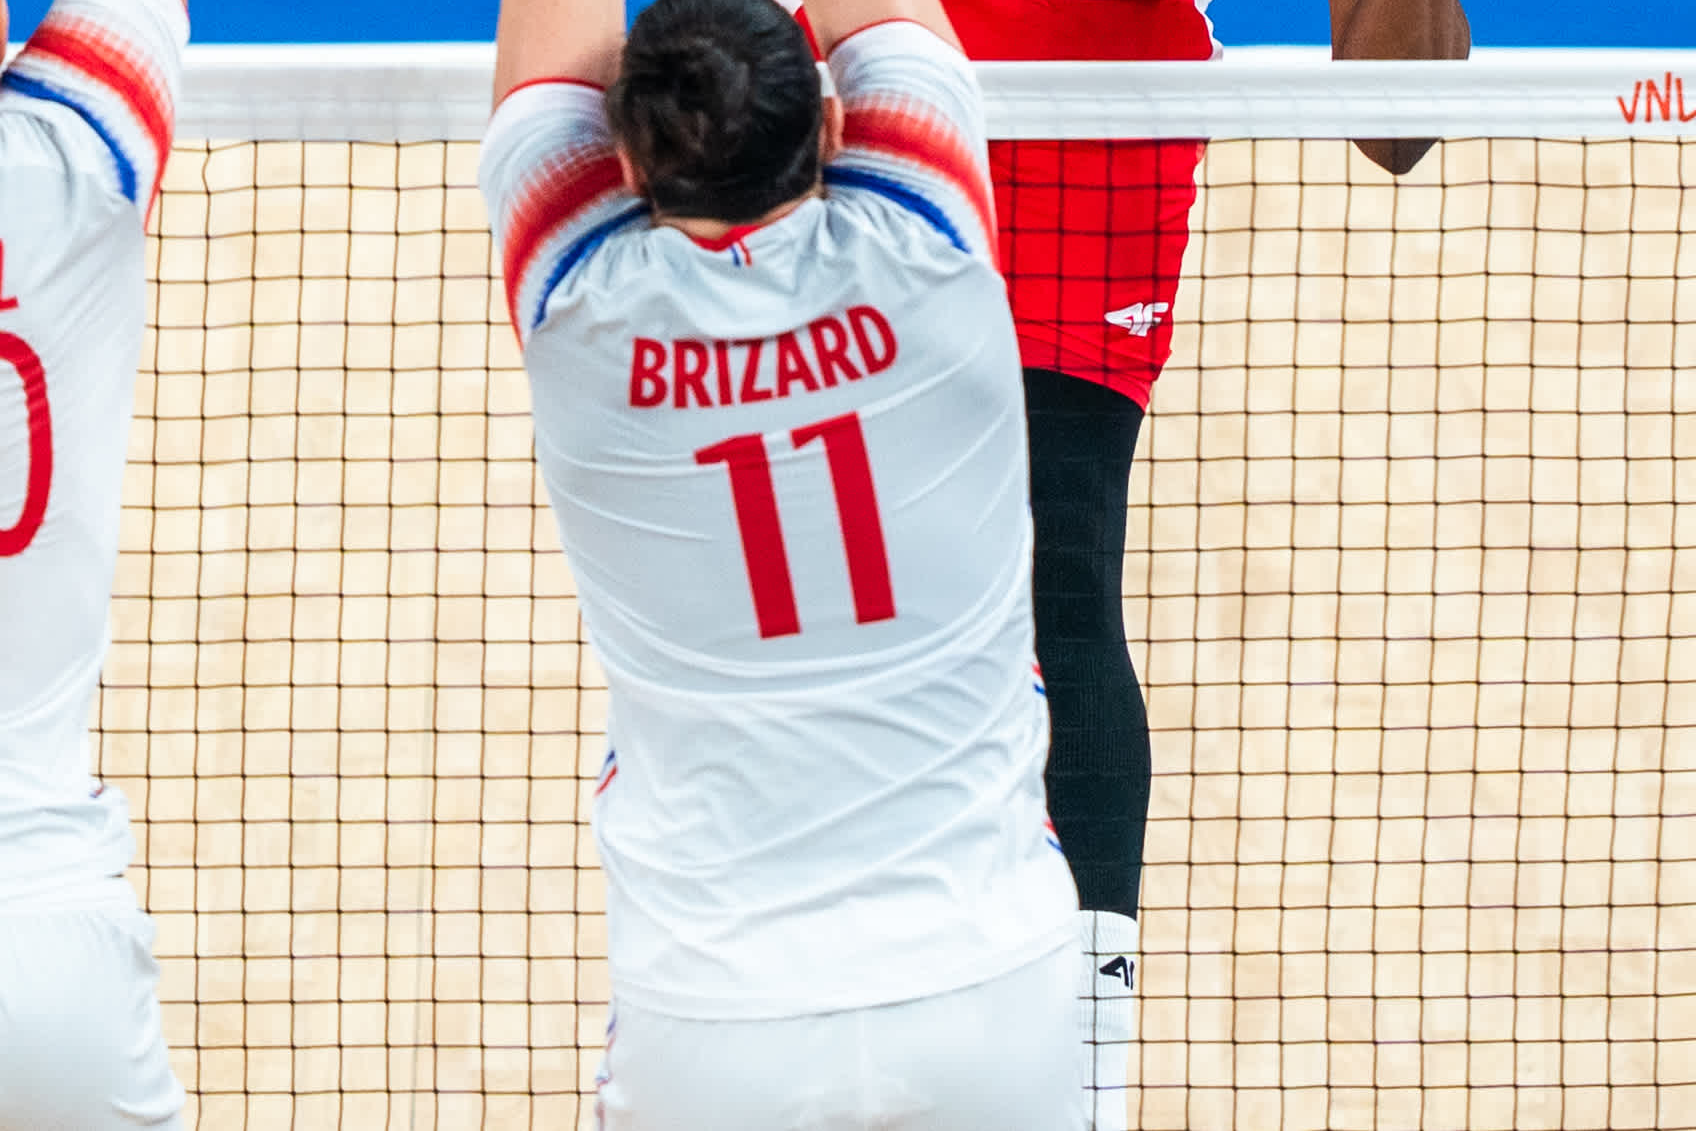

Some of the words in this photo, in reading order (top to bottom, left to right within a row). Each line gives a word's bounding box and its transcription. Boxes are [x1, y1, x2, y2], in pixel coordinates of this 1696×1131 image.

[1616, 70, 1696, 124] VNL
[628, 305, 898, 410] BRIZARD
[1104, 302, 1169, 337] 4F
[693, 411, 897, 640] 11
